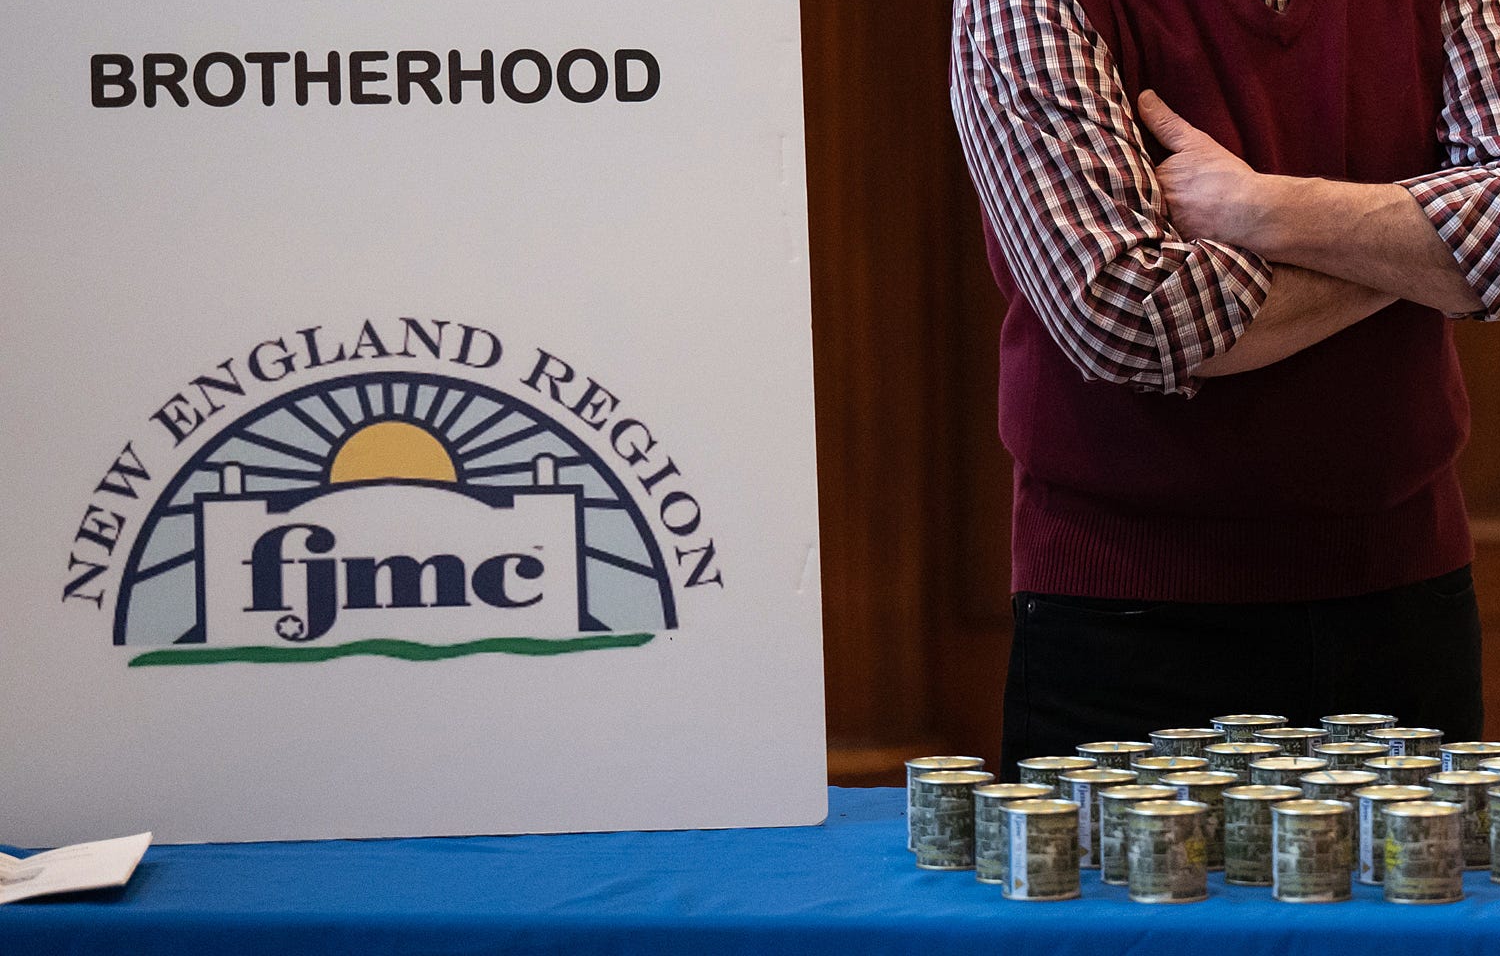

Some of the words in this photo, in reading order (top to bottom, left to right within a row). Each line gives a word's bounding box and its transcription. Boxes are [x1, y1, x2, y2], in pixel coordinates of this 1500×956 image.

[90, 48, 661, 109] BROTHERHOOD
[61, 442, 153, 610] NEW
[149, 317, 504, 446] ENGLAND
[519, 347, 725, 590] REGION
[242, 524, 545, 642] fjmc
